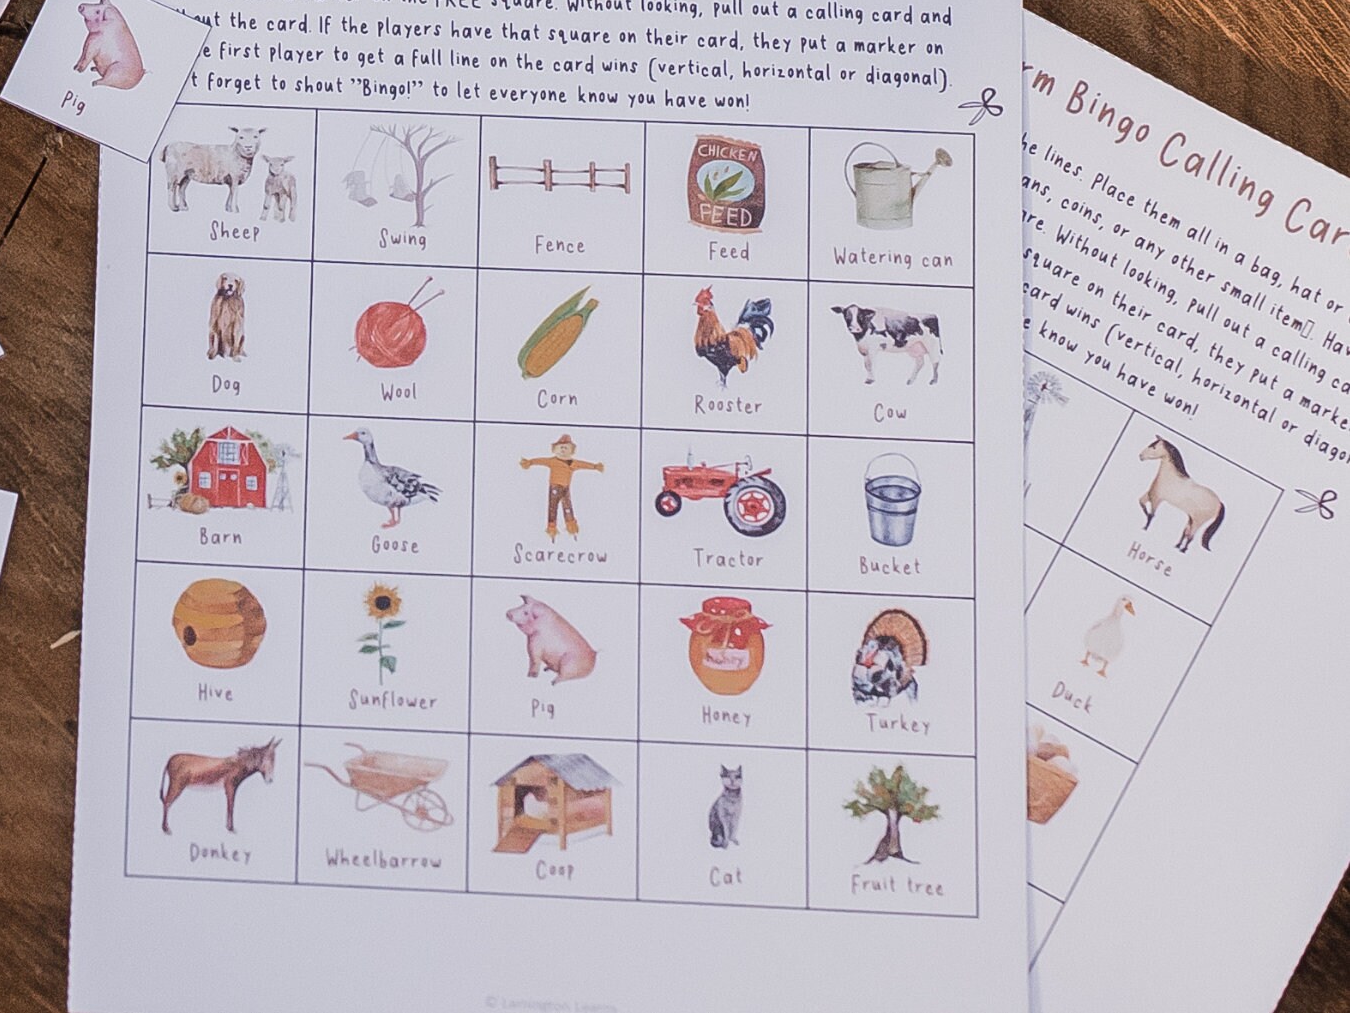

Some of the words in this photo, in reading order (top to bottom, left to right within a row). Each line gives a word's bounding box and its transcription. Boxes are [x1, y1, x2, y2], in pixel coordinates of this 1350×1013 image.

[752, 1, 778, 16] out
[787, 7, 797, 19] a
[806, 1, 863, 25] calling
[872, 5, 912, 25] card
[921, 6, 952, 26] and
[208, 72, 260, 94] forget
[272, 74, 286, 90] to
[295, 75, 342, 93] shout
[433, 80, 448, 97] to
[458, 81, 480, 99] let
[490, 89, 567, 105] everyone
[578, 85, 618, 103] know
[628, 93, 655, 108] you
[665, 89, 706, 108] have
[715, 94, 749, 112] won!
[61, 91, 85, 115] Pig
[697, 144, 758, 162] CHICKEN
[1066, 80, 1150, 144] Bingo
[1160, 132, 1274, 217] Calling
[699, 203, 752, 227] FEED
[210, 219, 264, 242] Sheep
[380, 228, 426, 250] Swing
[536, 235, 585, 254] Fence
[710, 241, 749, 261] Feed
[834, 247, 911, 269] Watering
[922, 256, 952, 267] can
[1039, 320, 1078, 352] know
[1084, 350, 1111, 371] you
[1116, 362, 1156, 396] have
[1164, 392, 1199, 420] won!
[1066, 304, 1100, 328] wins
[1105, 324, 1183, 379] (vertical,
[1191, 367, 1277, 423] horizontal
[213, 375, 240, 396] Dog
[381, 383, 416, 401] Wool
[538, 389, 577, 408] Corn
[695, 395, 762, 414] Rooster
[874, 403, 906, 423] Cow
[200, 527, 241, 545] Barn
[372, 535, 419, 553] Goose
[514, 542, 607, 564] Scarecrow
[693, 548, 763, 567] Tractor
[1127, 541, 1176, 577] Horse
[860, 556, 920, 575] Bucket
[199, 683, 233, 701] Hive
[349, 688, 437, 710] Sunflower
[1050, 681, 1092, 716] Duck
[532, 698, 554, 719] Pig
[702, 706, 751, 727] Honey
[866, 713, 930, 735] Turkey
[190, 842, 251, 865] Donkey
[326, 848, 441, 869] Wheelbarrow
[536, 860, 574, 881] Coop
[710, 866, 742, 887] Cat
[852, 874, 895, 894] Fruit
[908, 877, 944, 896] tree
